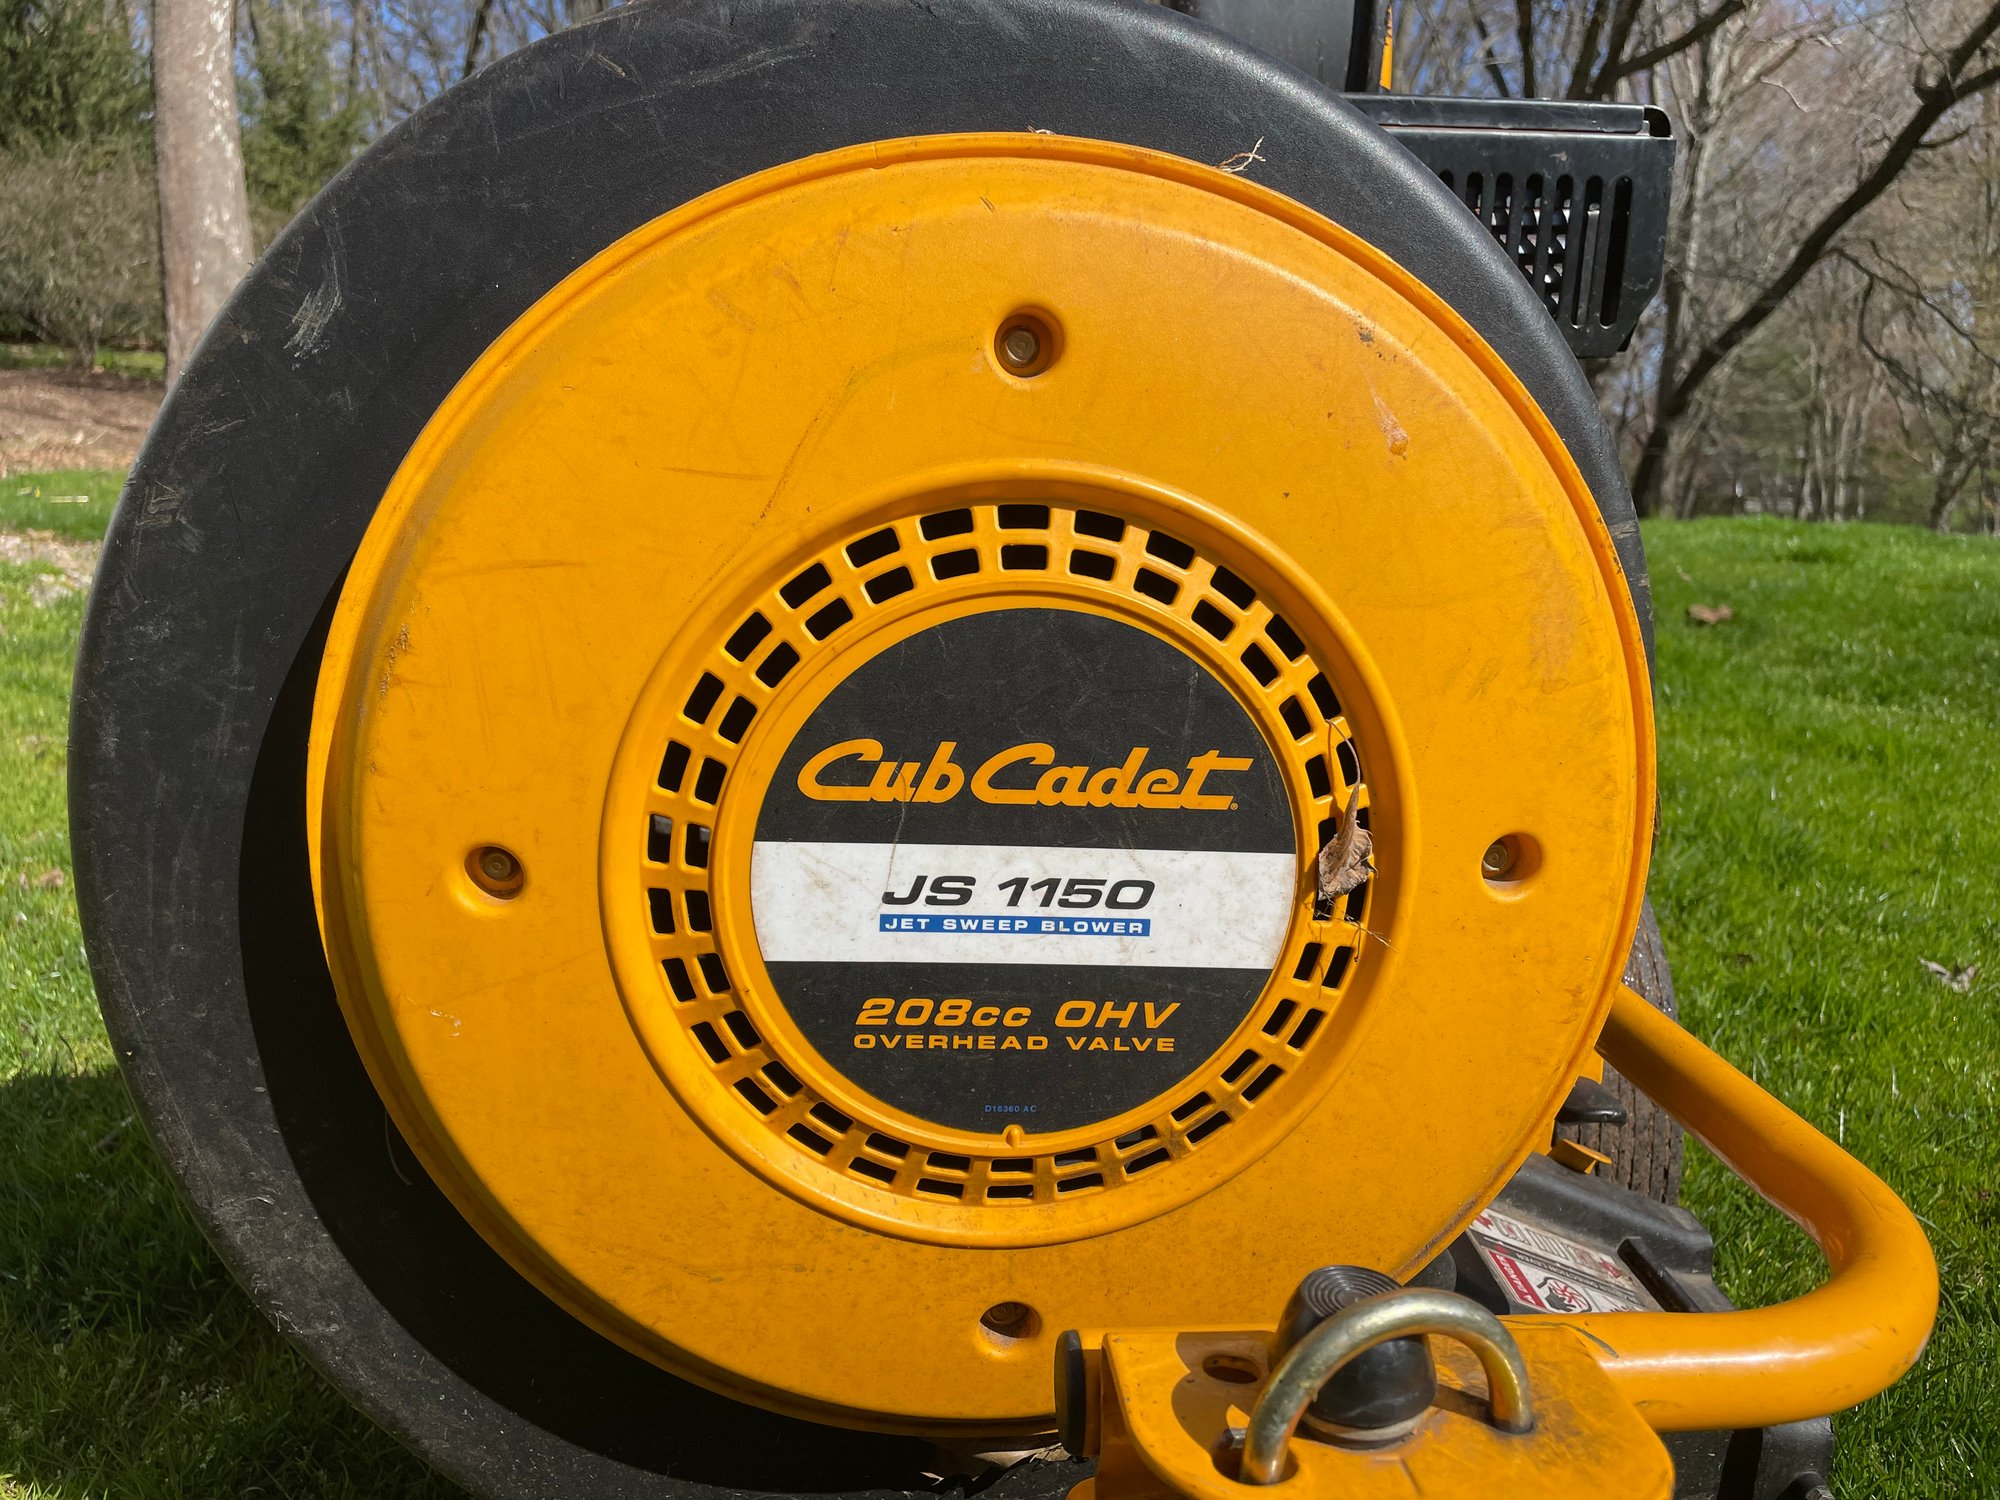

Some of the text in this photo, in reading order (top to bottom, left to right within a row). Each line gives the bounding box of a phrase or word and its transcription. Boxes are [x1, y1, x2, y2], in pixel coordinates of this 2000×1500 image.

[797, 739, 1253, 810] Cub Cadet
[882, 876, 1155, 909] JS 1150
[885, 918, 1143, 934] JET SWEEP BLOWER
[856, 998, 1180, 1028] 208cc OHV
[854, 1034, 1174, 1051] OVERHEAD VALVE
[1023, 1104, 1037, 1113] AC
[1496, 1254, 1525, 1293] DANGER
